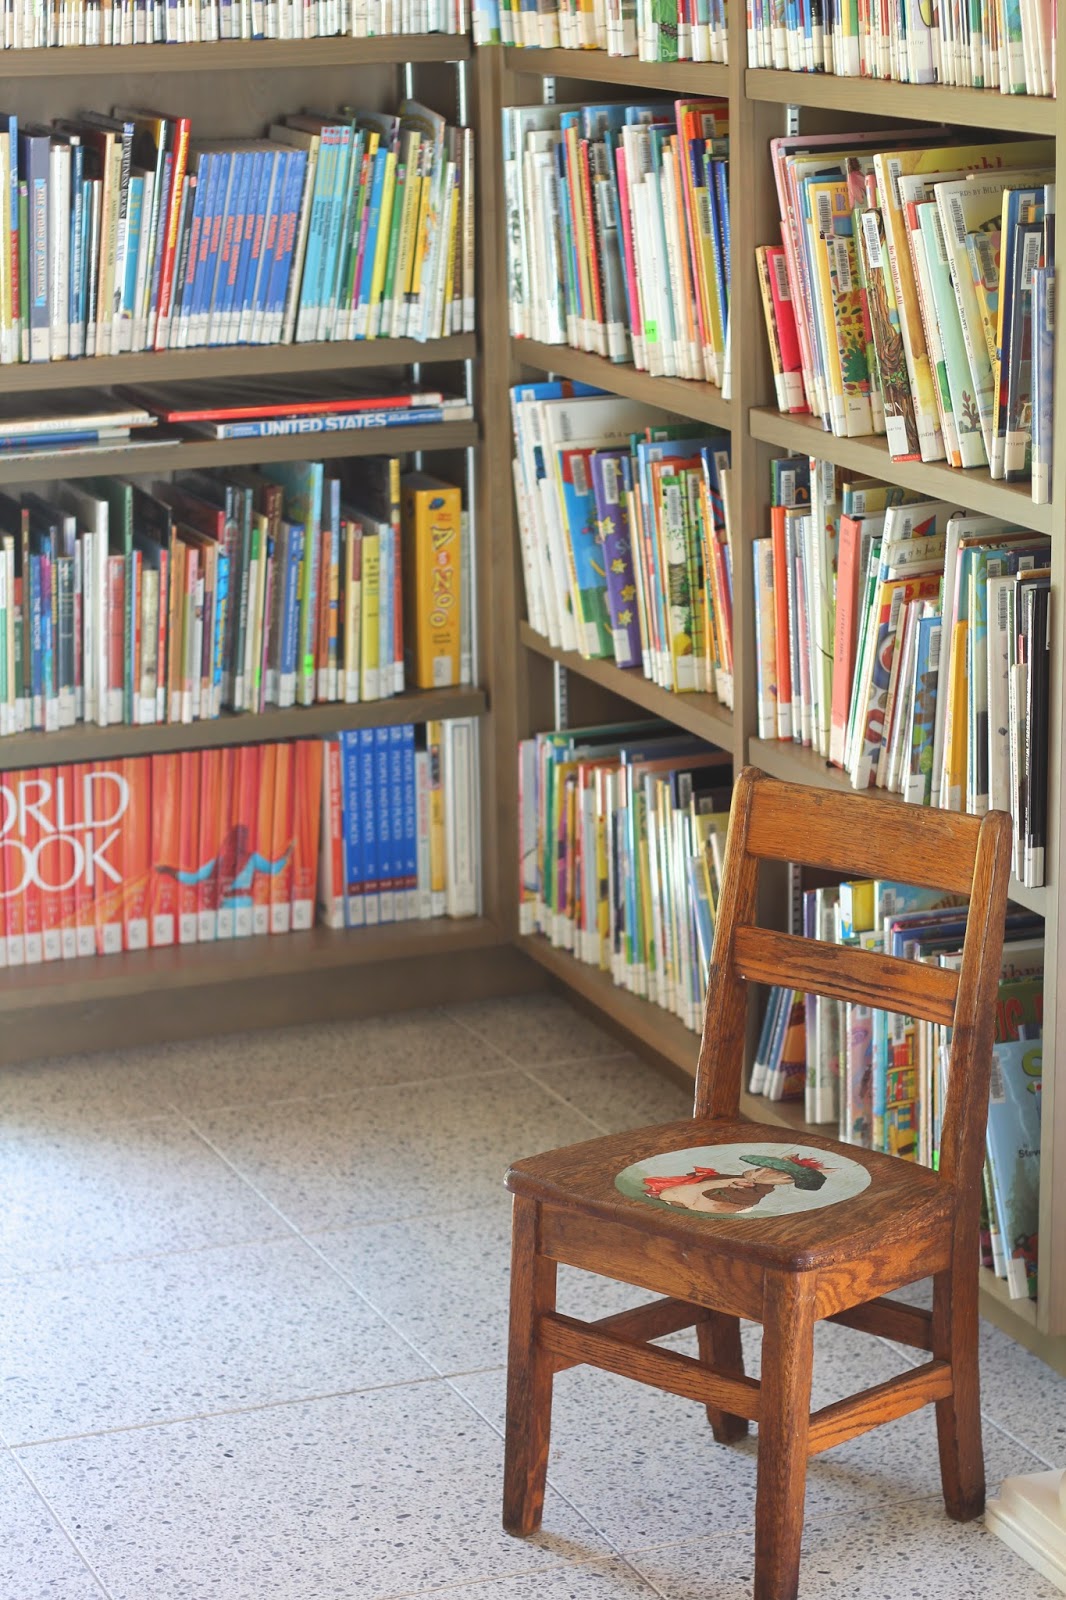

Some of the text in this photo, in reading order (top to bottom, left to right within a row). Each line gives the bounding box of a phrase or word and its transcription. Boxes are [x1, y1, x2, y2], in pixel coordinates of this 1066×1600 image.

[119, 135, 132, 219] EYEWITNESS BOOKS
[176, 131, 189, 173] Presidential
[36, 186, 47, 299] THE STORY OF AMERICA
[116, 221, 126, 262] CIVIL WAR
[199, 216, 212, 262] NEW YORK
[210, 215, 222, 253] VIRGINIA
[222, 215, 235, 262] MARYLAND
[252, 214, 264, 259] LOUISIANA
[266, 214, 278, 250] FLORIDA
[227, 244, 240, 286] CAROLINA
[888, 244, 904, 306] No Trouble at All
[260, 416, 323, 436] UNITED
[324, 411, 388, 431] STATES
[430, 525, 458, 552] A
[33, 596, 41, 651] THE WATCHER
[428, 567, 456, 630] ZOO
[348, 755, 359, 845] PEOPLE AND PLACES
[363, 753, 374, 843] PEOPLE AND PLACES
[379, 751, 389, 841] PEOPLE AND PLACES
[392, 750, 402, 840] PEOPLE AND PLACES
[404, 749, 414, 839] PEOPLE AND PLACES
